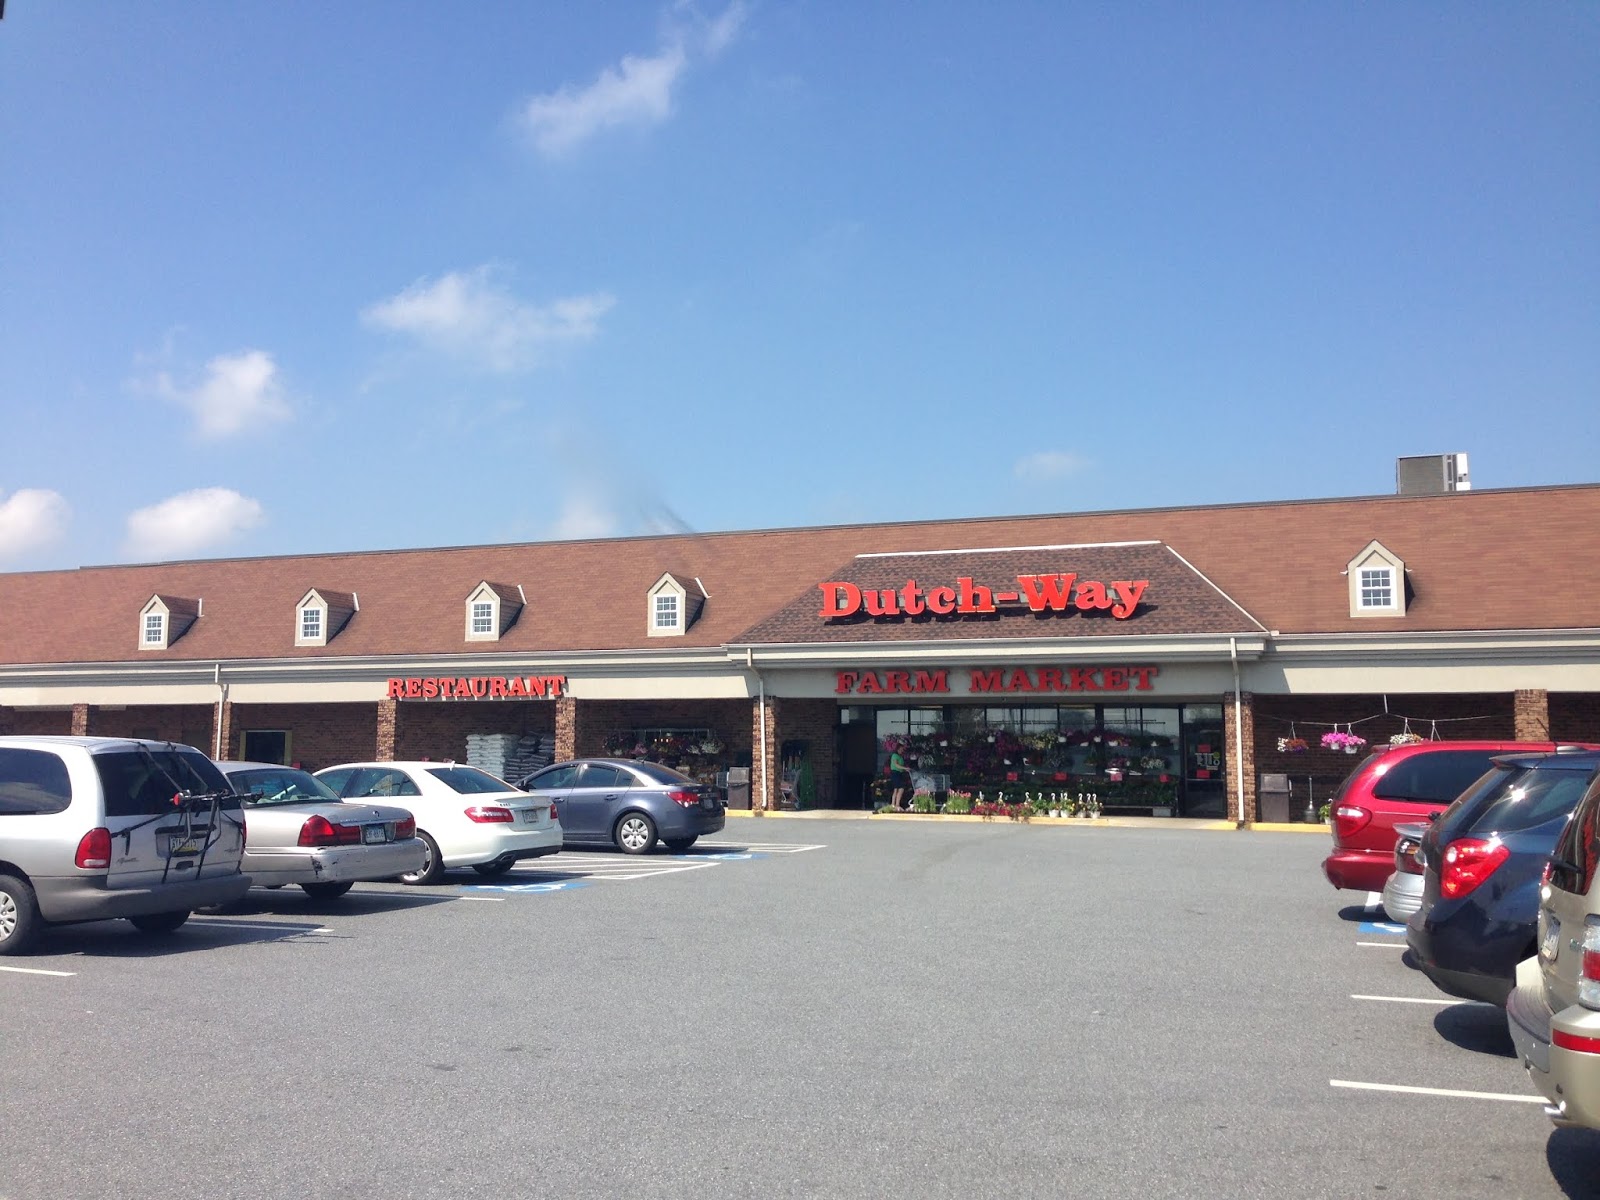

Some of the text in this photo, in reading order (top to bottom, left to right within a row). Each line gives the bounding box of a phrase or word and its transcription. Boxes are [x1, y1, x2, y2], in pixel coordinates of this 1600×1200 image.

[818, 572, 1149, 619] Dutch-Way
[386, 675, 566, 698] RESTAURANT
[835, 667, 1158, 693] FARM MARKET
